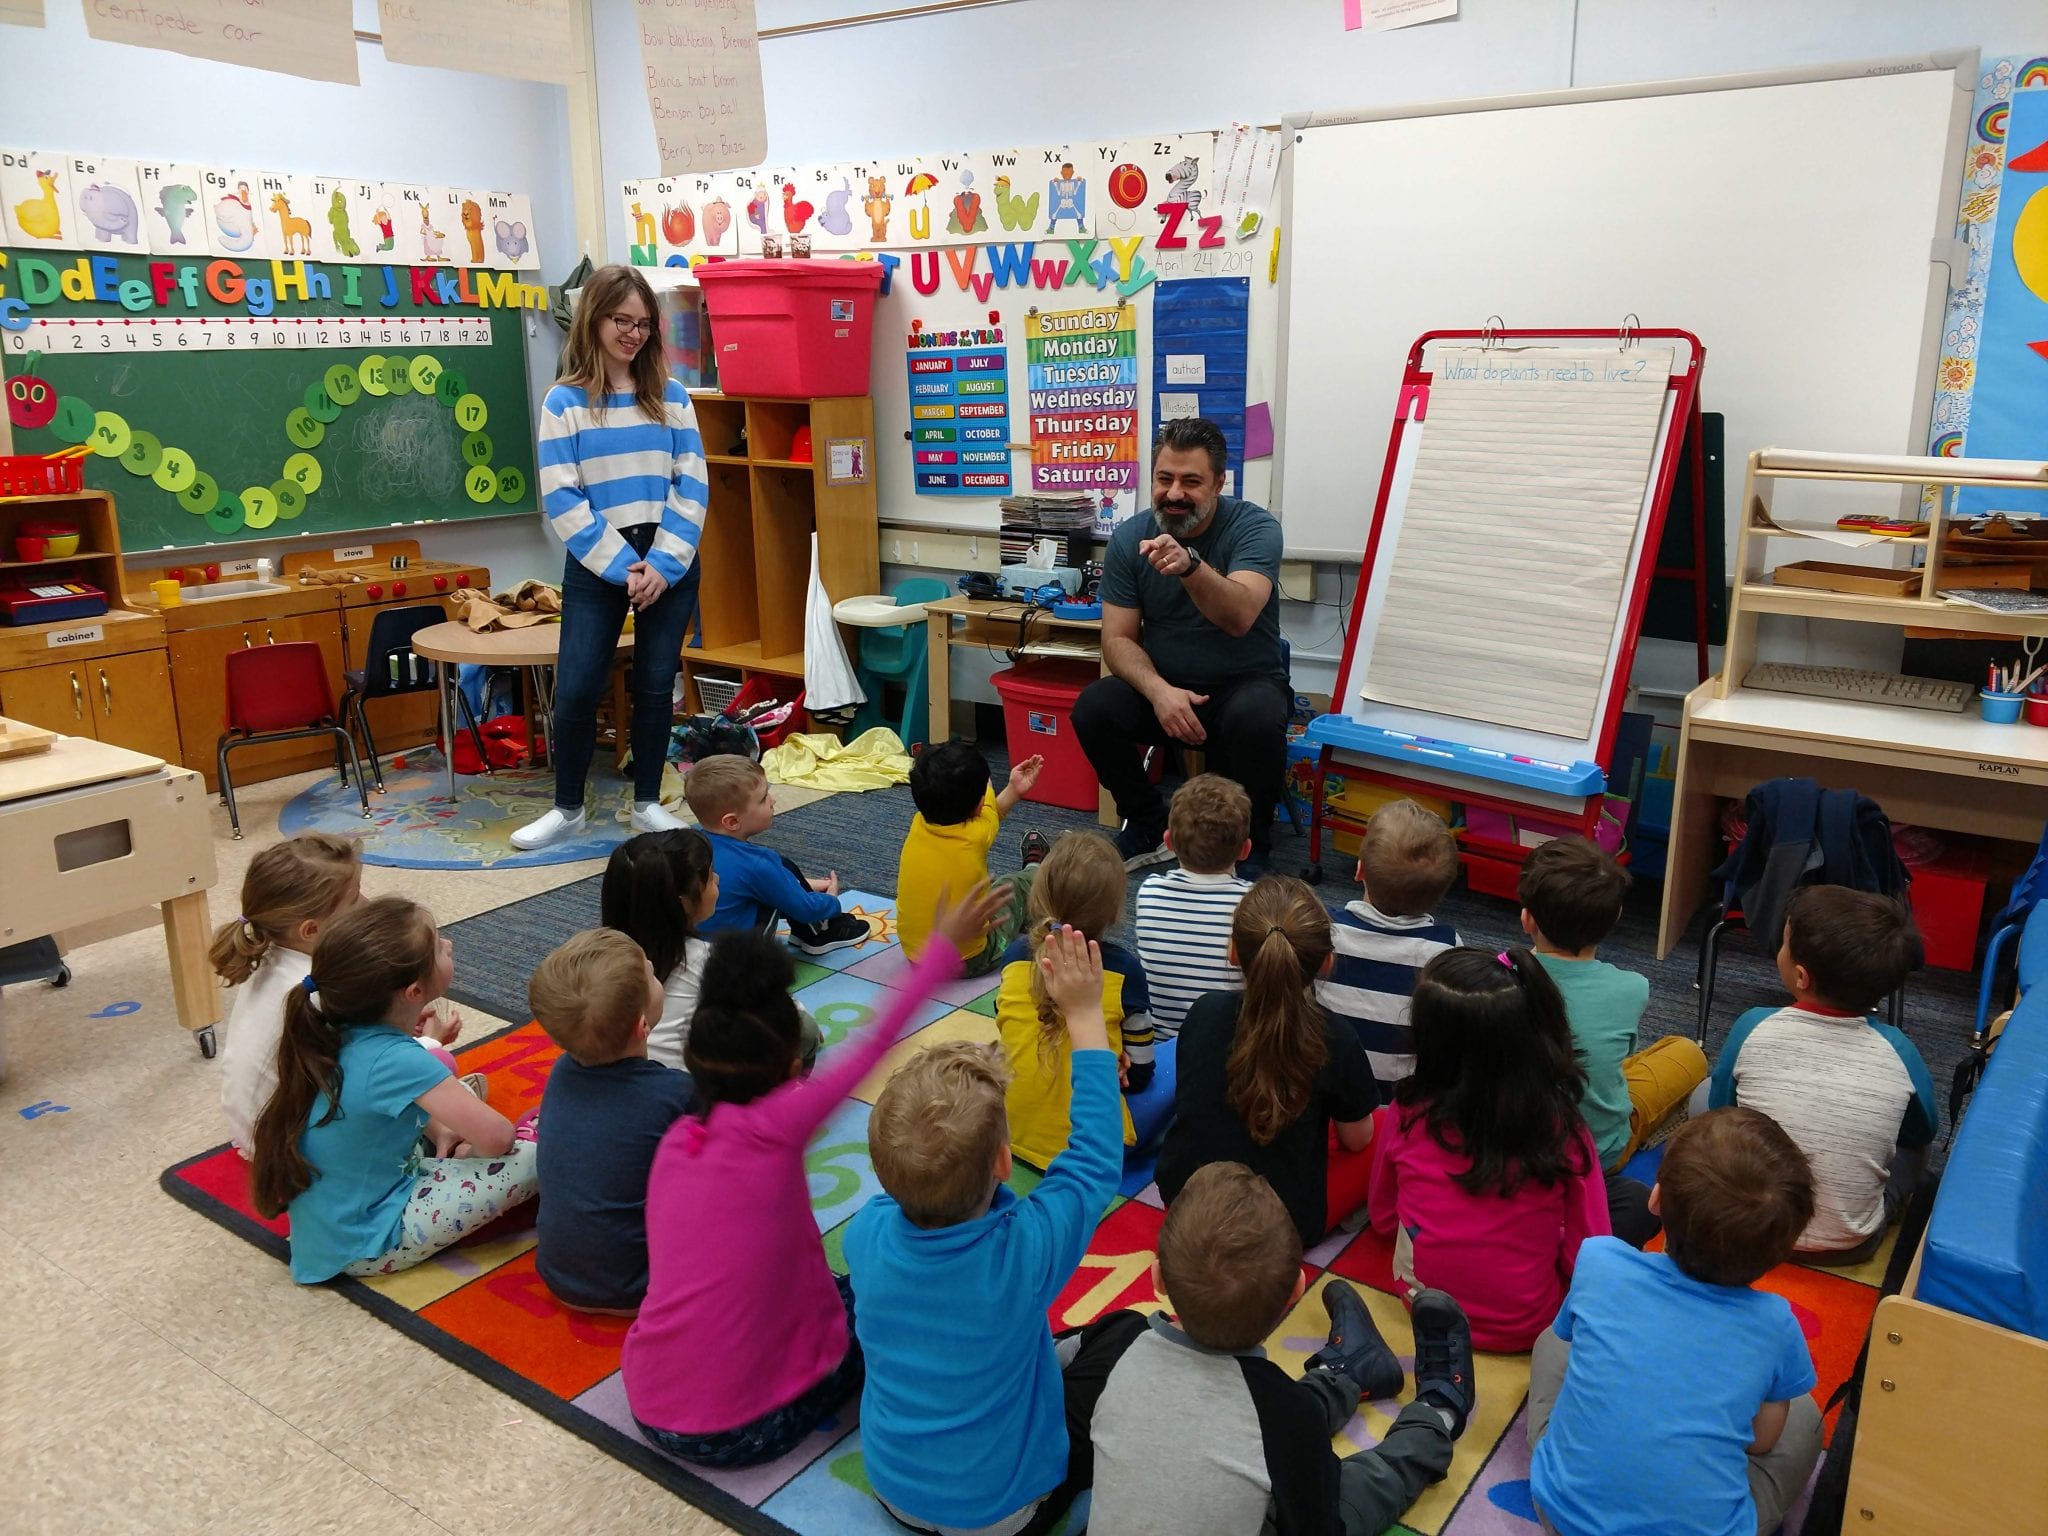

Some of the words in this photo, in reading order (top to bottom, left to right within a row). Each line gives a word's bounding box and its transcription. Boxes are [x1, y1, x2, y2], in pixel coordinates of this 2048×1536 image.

[222, 24, 264, 41] car
[1156, 251, 1184, 277] April
[1221, 250, 1254, 273] 2019
[911, 251, 940, 295] U
[1040, 311, 1119, 335] Sunday
[13, 336, 24, 350] 0
[46, 336, 51, 349] 1
[72, 336, 83, 349] 2
[101, 335, 110, 347] 3
[126, 334, 136, 347] 4
[152, 333, 162, 347] 5
[178, 333, 188, 346] 6
[202, 333, 212, 345] 7
[227, 333, 235, 345] 8
[250, 333, 259, 345] 9
[272, 332, 286, 345] 10
[297, 332, 306, 344] 11
[316, 332, 328, 344] 12
[339, 331, 351, 343] 13
[360, 331, 371, 343] 14
[380, 331, 391, 343] 15
[400, 331, 411, 343] 16
[420, 331, 431, 343] 17
[439, 331, 450, 342] 18
[458, 331, 468, 342] 19
[476, 330, 489, 342] 20
[907, 330, 958, 349] MONTHS
[971, 328, 1003, 345] YEAR
[1043, 336, 1118, 358] Monday
[915, 360, 948, 371] JANUARY
[969, 357, 989, 369] JULY
[1172, 363, 1201, 375] author
[1444, 360, 1478, 381] What
[1604, 360, 1647, 382] live?
[391, 368, 407, 384] 14
[418, 366, 436, 386] 15
[1043, 363, 1120, 384] Tuesday
[334, 374, 354, 394] 12
[445, 380, 460, 397] 16
[915, 383, 949, 394] FEBRUARY
[965, 382, 995, 392] AUGUST
[1030, 388, 1136, 410] Wednesday
[466, 406, 480, 422] 17
[921, 408, 945, 417] MARCH
[960, 406, 1004, 416] SEPTEMBER
[296, 416, 316, 438] 10
[1035, 414, 1132, 435] Thursday
[98, 426, 117, 444] 2
[925, 430, 944, 440] APRIL
[965, 428, 1001, 438] OCTOBER
[133, 443, 145, 461] 3
[471, 441, 487, 457] 18
[963, 451, 1006, 462] NOVEMBER
[1051, 441, 1115, 461] Friday
[928, 453, 943, 463] MAY
[167, 460, 180, 478] 4
[1038, 465, 1131, 485] Saturday
[474, 476, 489, 493] 19
[501, 476, 519, 492] 20
[928, 475, 947, 485] JUNE
[965, 475, 1005, 485] DECEMBER
[189, 483, 205, 499] 5
[279, 491, 295, 506] 8
[252, 499, 263, 516] 7
[343, 549, 364, 558] stove
[234, 562, 252, 572] sink
[56, 630, 95, 643] cabinet
[1978, 763, 2020, 775] KAPLAN
